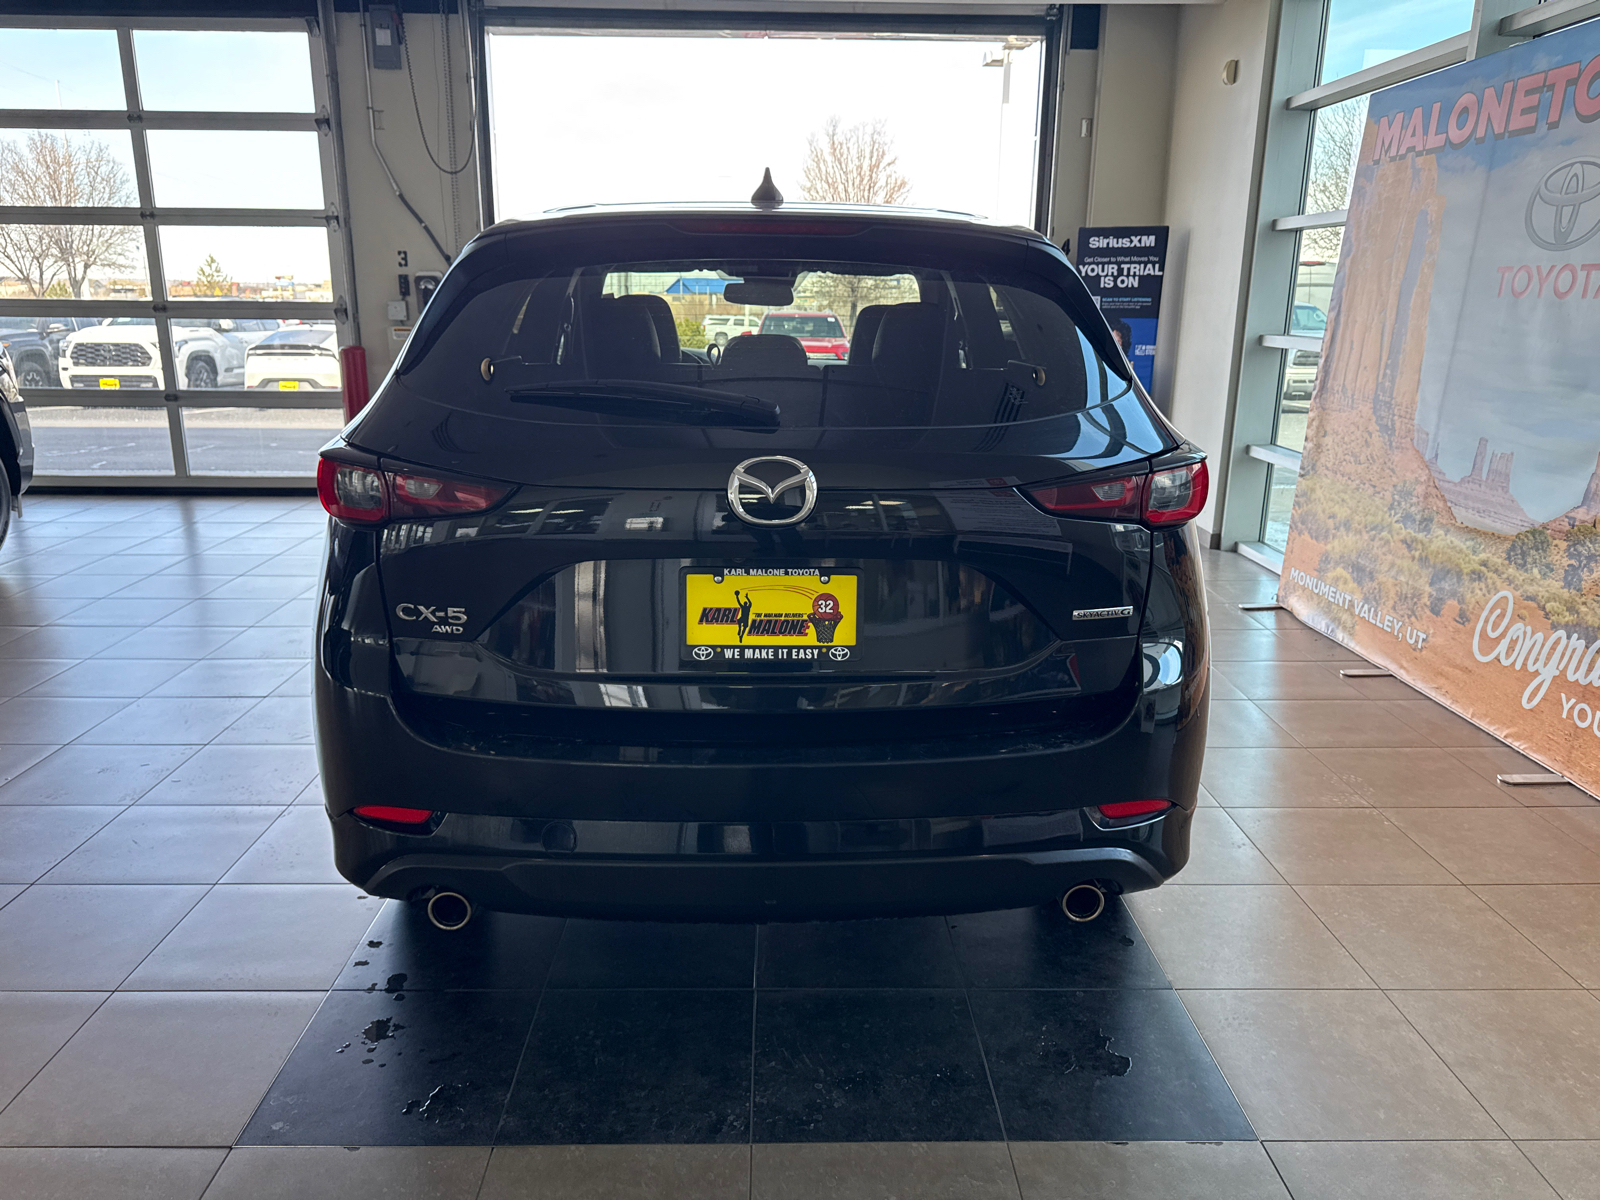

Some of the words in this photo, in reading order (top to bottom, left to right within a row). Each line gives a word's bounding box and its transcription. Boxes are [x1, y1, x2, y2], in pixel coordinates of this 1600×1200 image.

[1088, 235, 1156, 249] SiriusXM
[397, 250, 408, 267] 3
[1079, 264, 1118, 277] YOUR
[1120, 263, 1164, 276] TRIAL
[1100, 276, 1114, 288] IS
[1116, 276, 1139, 288] ON
[1497, 263, 1600, 300] TOYOT
[723, 568, 747, 576] KARL
[749, 568, 785, 576] MALONE
[787, 568, 820, 576] TOYOTA
[395, 603, 468, 624] CX-5
[817, 600, 834, 613] 32
[1289, 567, 1352, 610] MONUMENT
[1354, 601, 1403, 642] VALLEY,
[1405, 626, 1428, 650] UT
[698, 607, 741, 625] KARL
[431, 624, 464, 634] AWD
[747, 618, 810, 636] MALONE
[724, 648, 740, 659] WE
[744, 648, 774, 659] MAKE
[778, 648, 788, 659] IT
[792, 648, 819, 659] EASY
